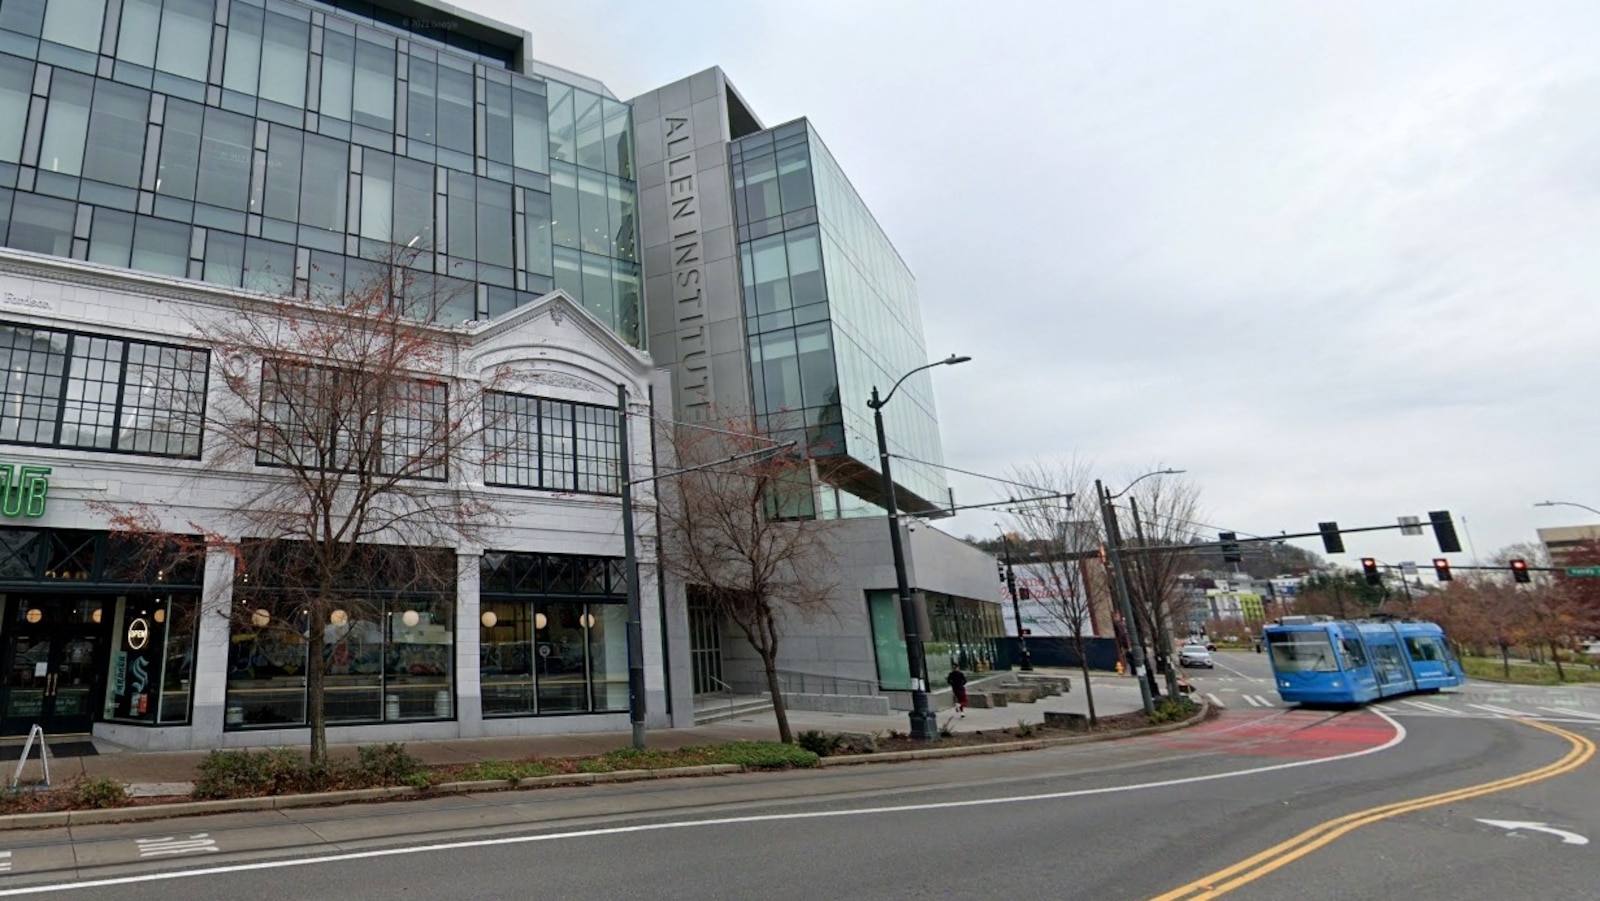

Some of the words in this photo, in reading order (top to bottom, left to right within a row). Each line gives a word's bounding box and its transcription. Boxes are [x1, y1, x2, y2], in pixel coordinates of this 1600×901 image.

[665, 116, 696, 219] ALLEN
[673, 229, 710, 421] INSTITUTE
[0, 464, 52, 517] UB
